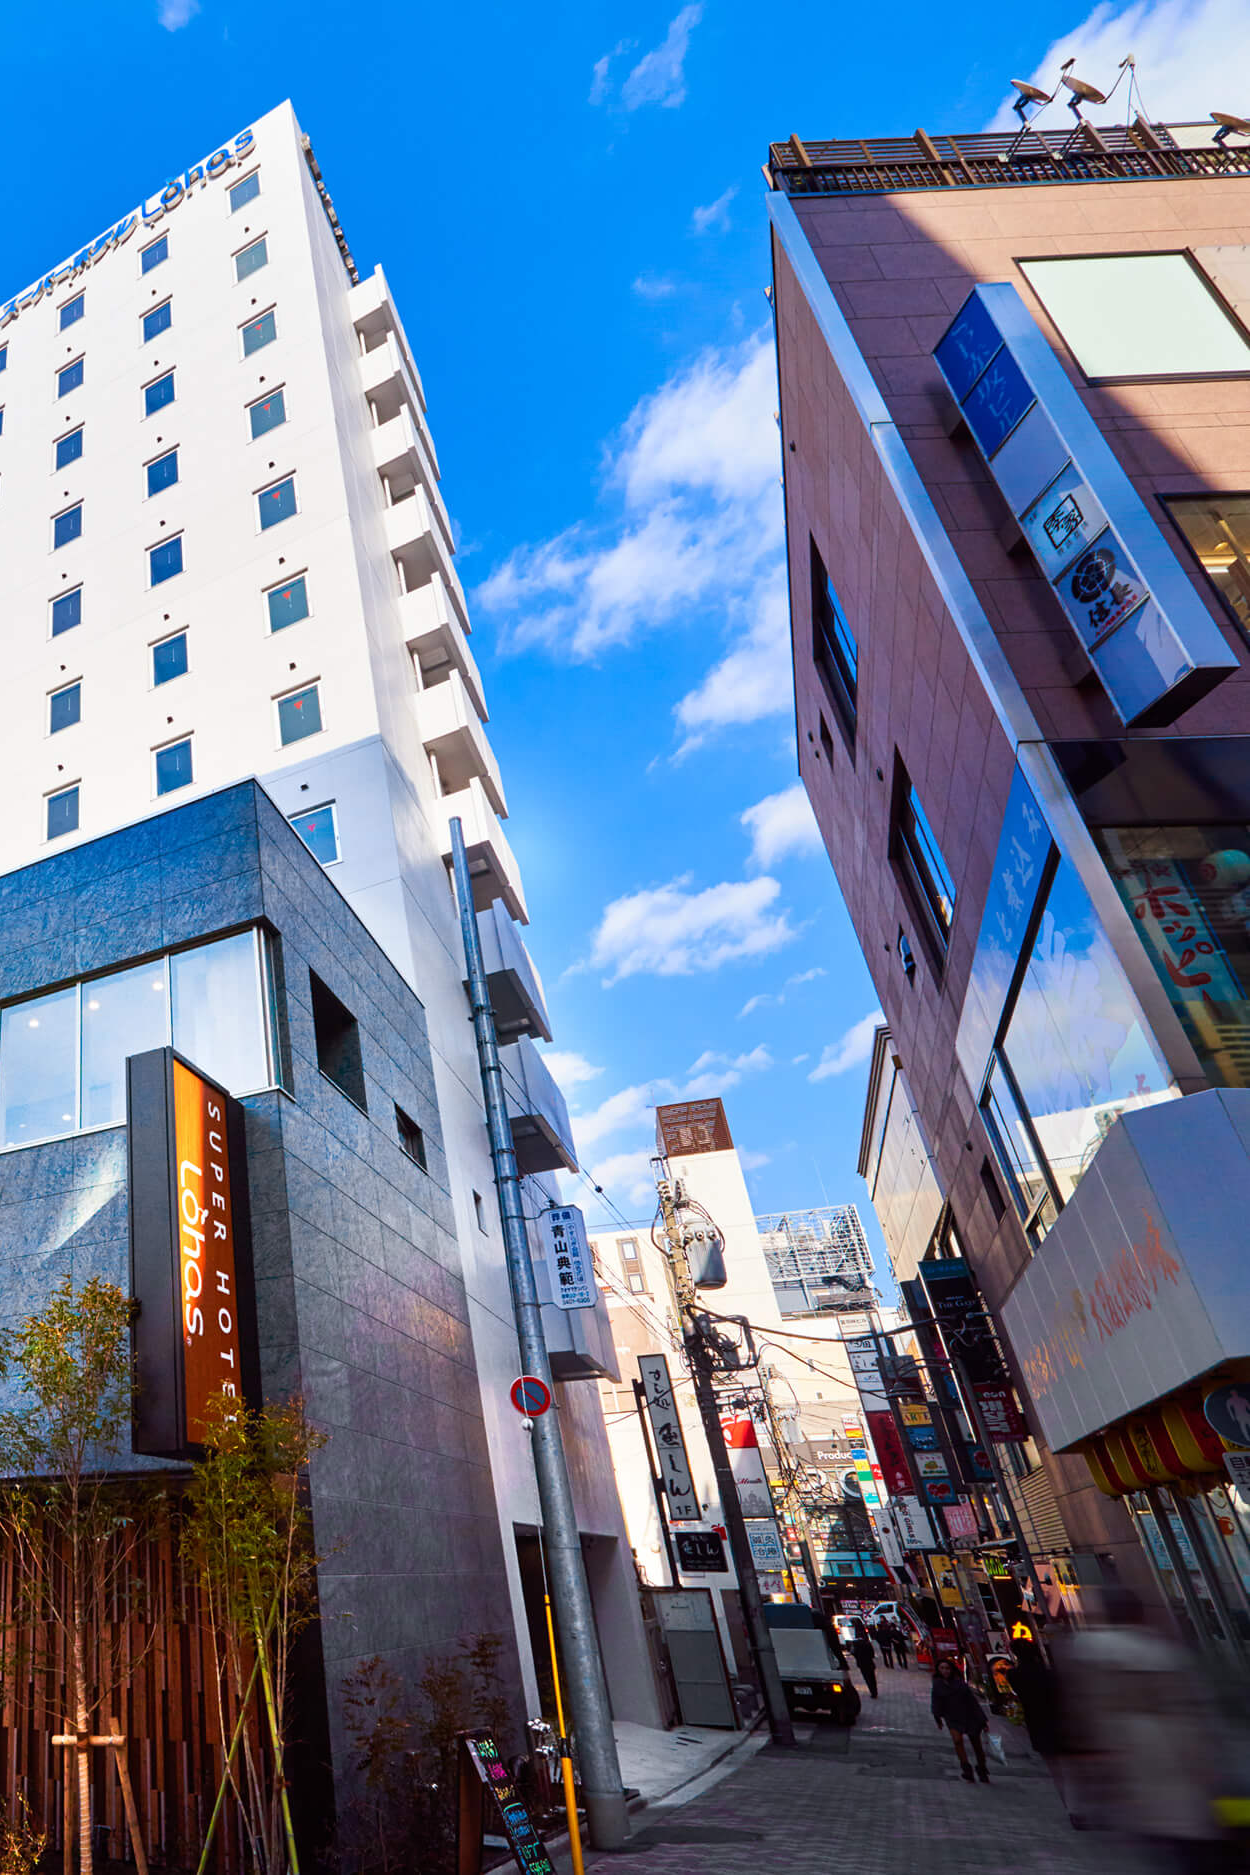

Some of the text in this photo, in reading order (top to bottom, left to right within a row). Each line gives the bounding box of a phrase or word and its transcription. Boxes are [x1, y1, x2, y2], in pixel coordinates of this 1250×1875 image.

[208, 1101, 228, 1242] SUPER
[551, 1224, 574, 1286] 青山典範
[676, 1504, 692, 1515] 1F
